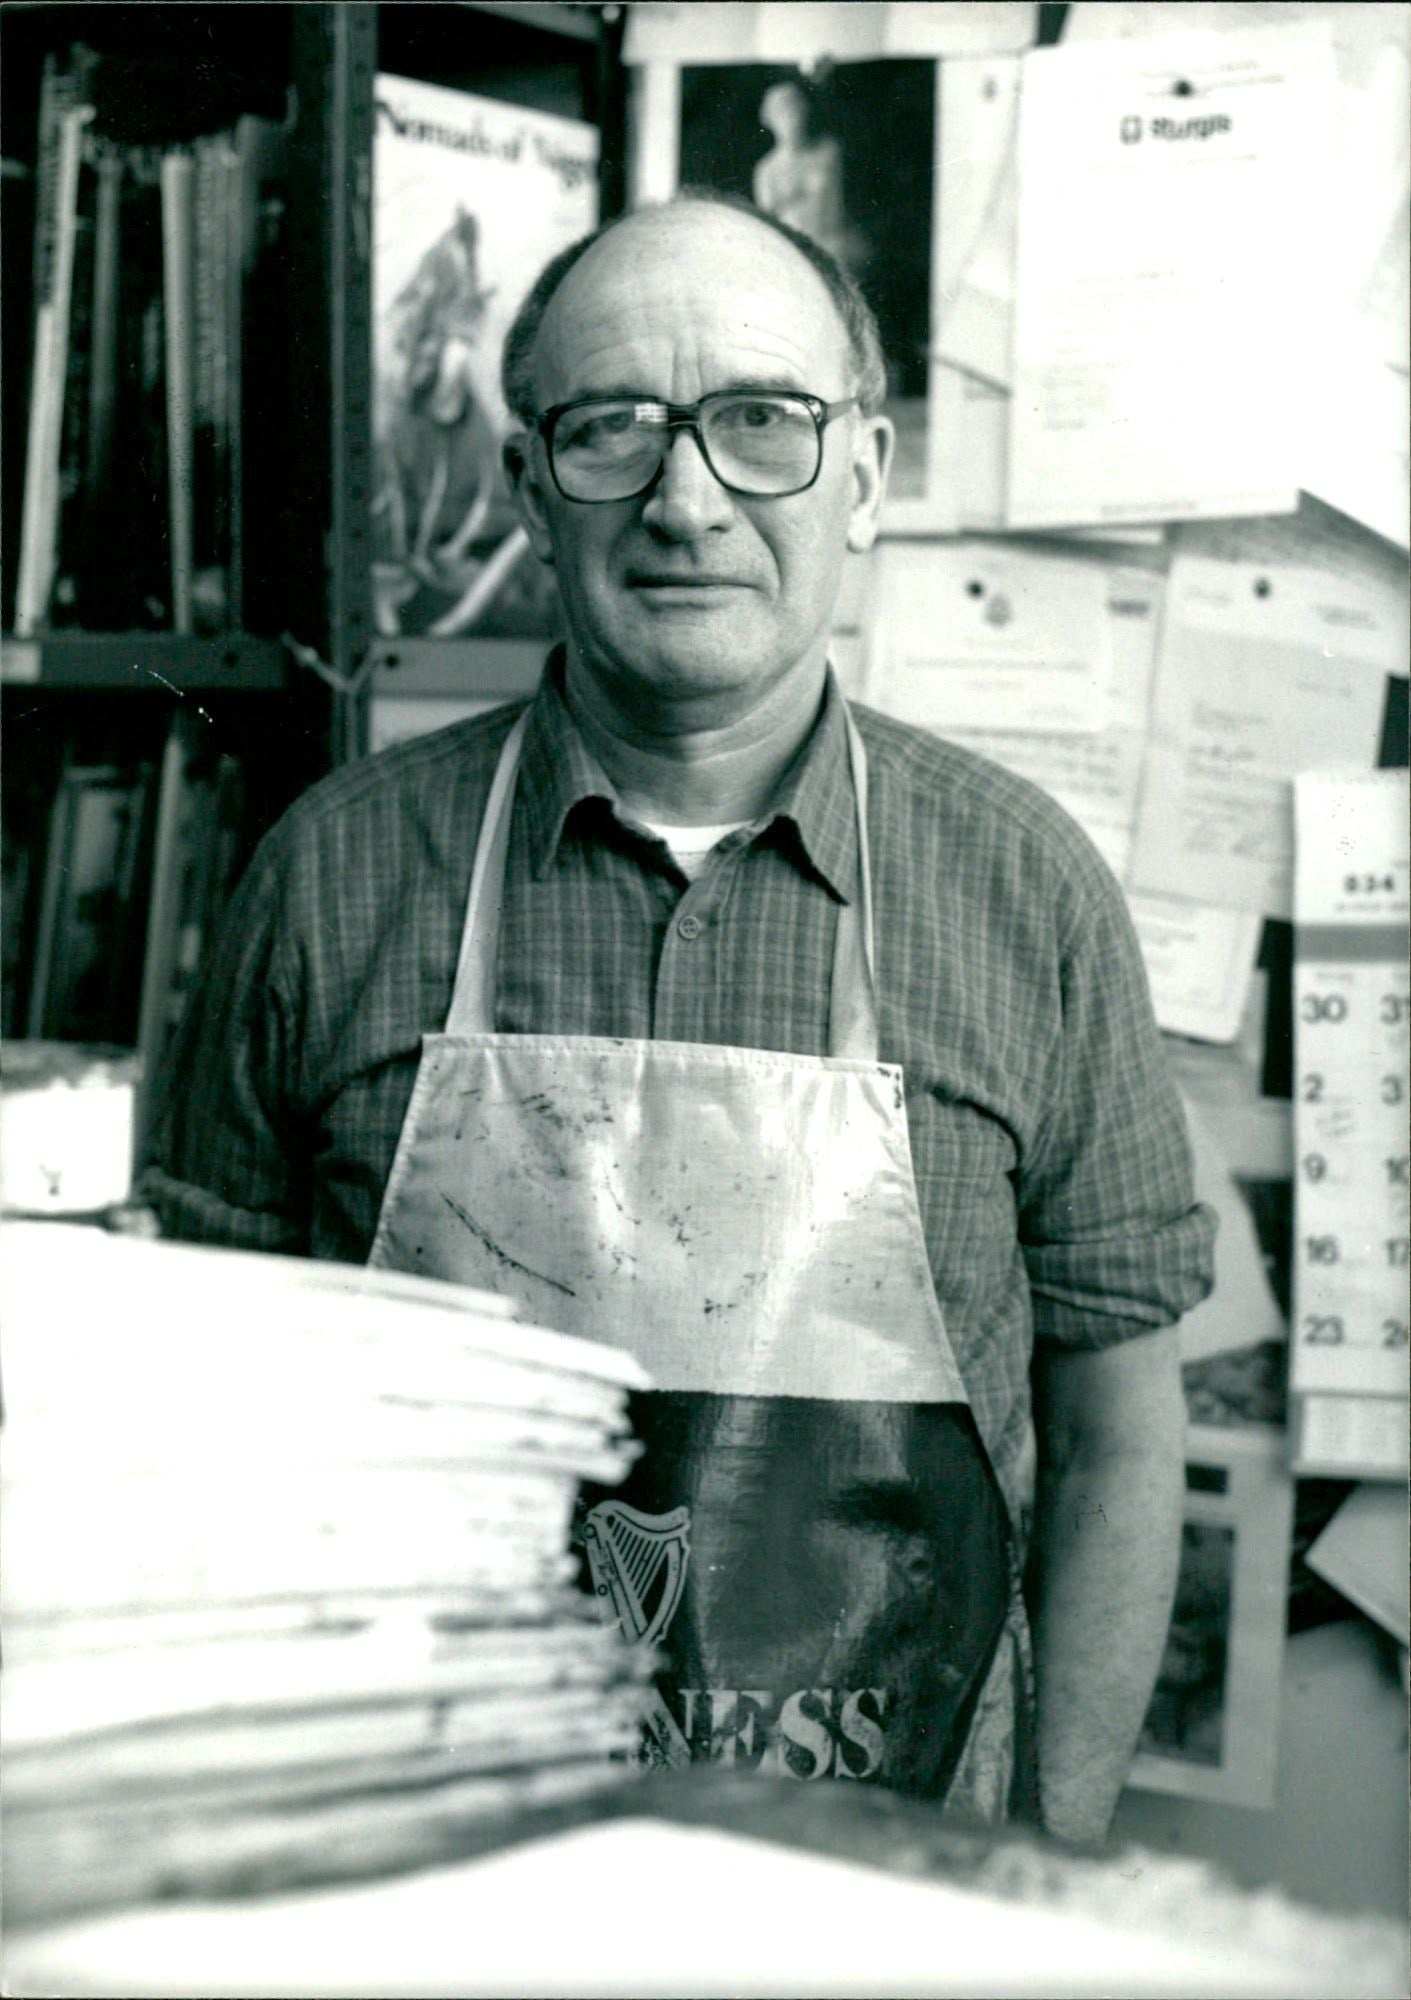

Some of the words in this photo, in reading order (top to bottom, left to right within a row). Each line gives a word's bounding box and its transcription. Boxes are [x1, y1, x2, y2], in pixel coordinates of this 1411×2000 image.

[1301, 993, 1348, 1025] 30
[1303, 1072, 1325, 1103] 2
[1381, 1074, 1404, 1106] 3
[1303, 1152, 1327, 1184] 9
[1305, 1234, 1341, 1267] 16
[1303, 1313, 1344, 1346] 23
[632, 1687, 887, 1781] NESS
